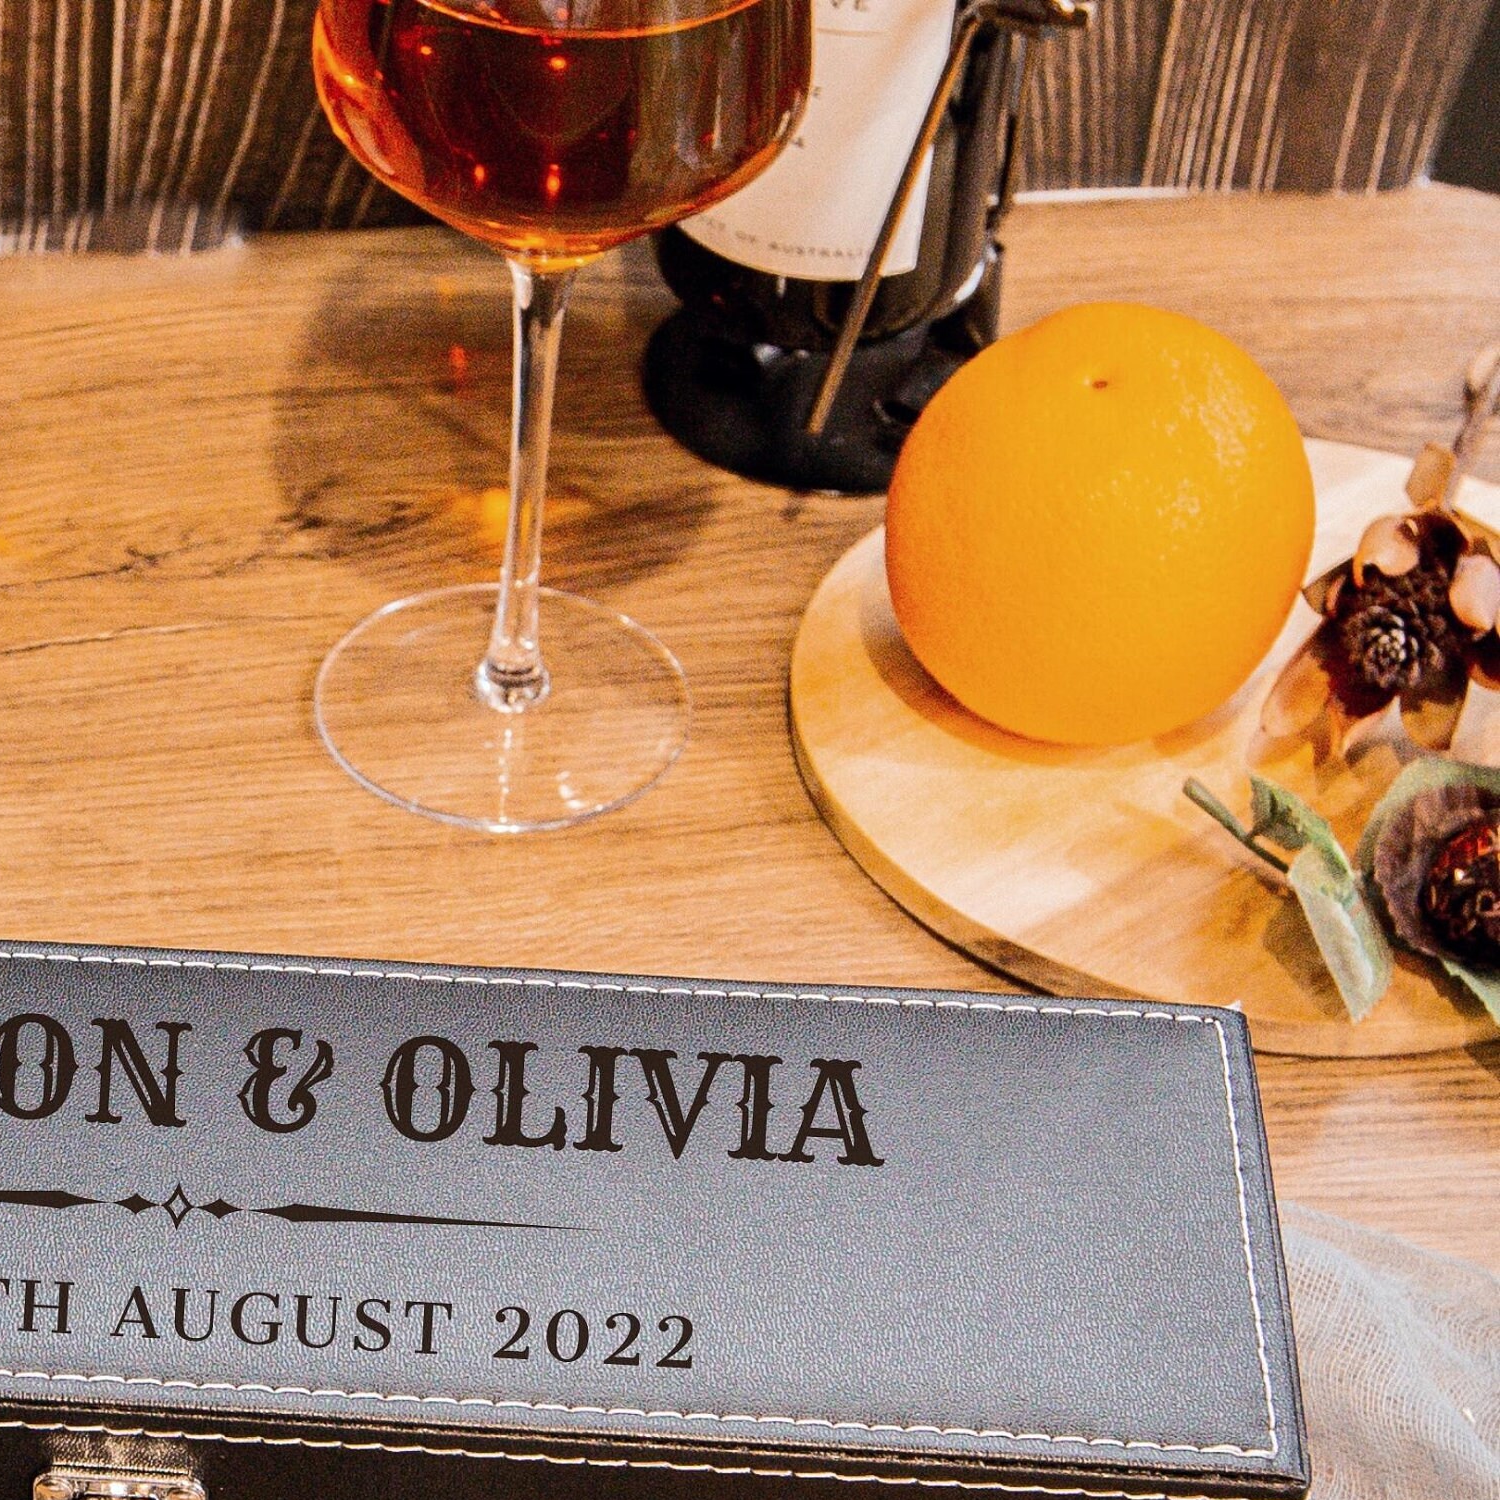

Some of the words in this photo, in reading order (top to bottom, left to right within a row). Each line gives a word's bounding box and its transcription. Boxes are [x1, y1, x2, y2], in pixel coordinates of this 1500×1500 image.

[768, 240, 863, 258] AUSTRALI
[236, 1027, 335, 1134] &
[379, 1034, 885, 1168] OLIVIA
[110, 1285, 454, 1356] AUGUST
[491, 1305, 695, 1370] 2022
